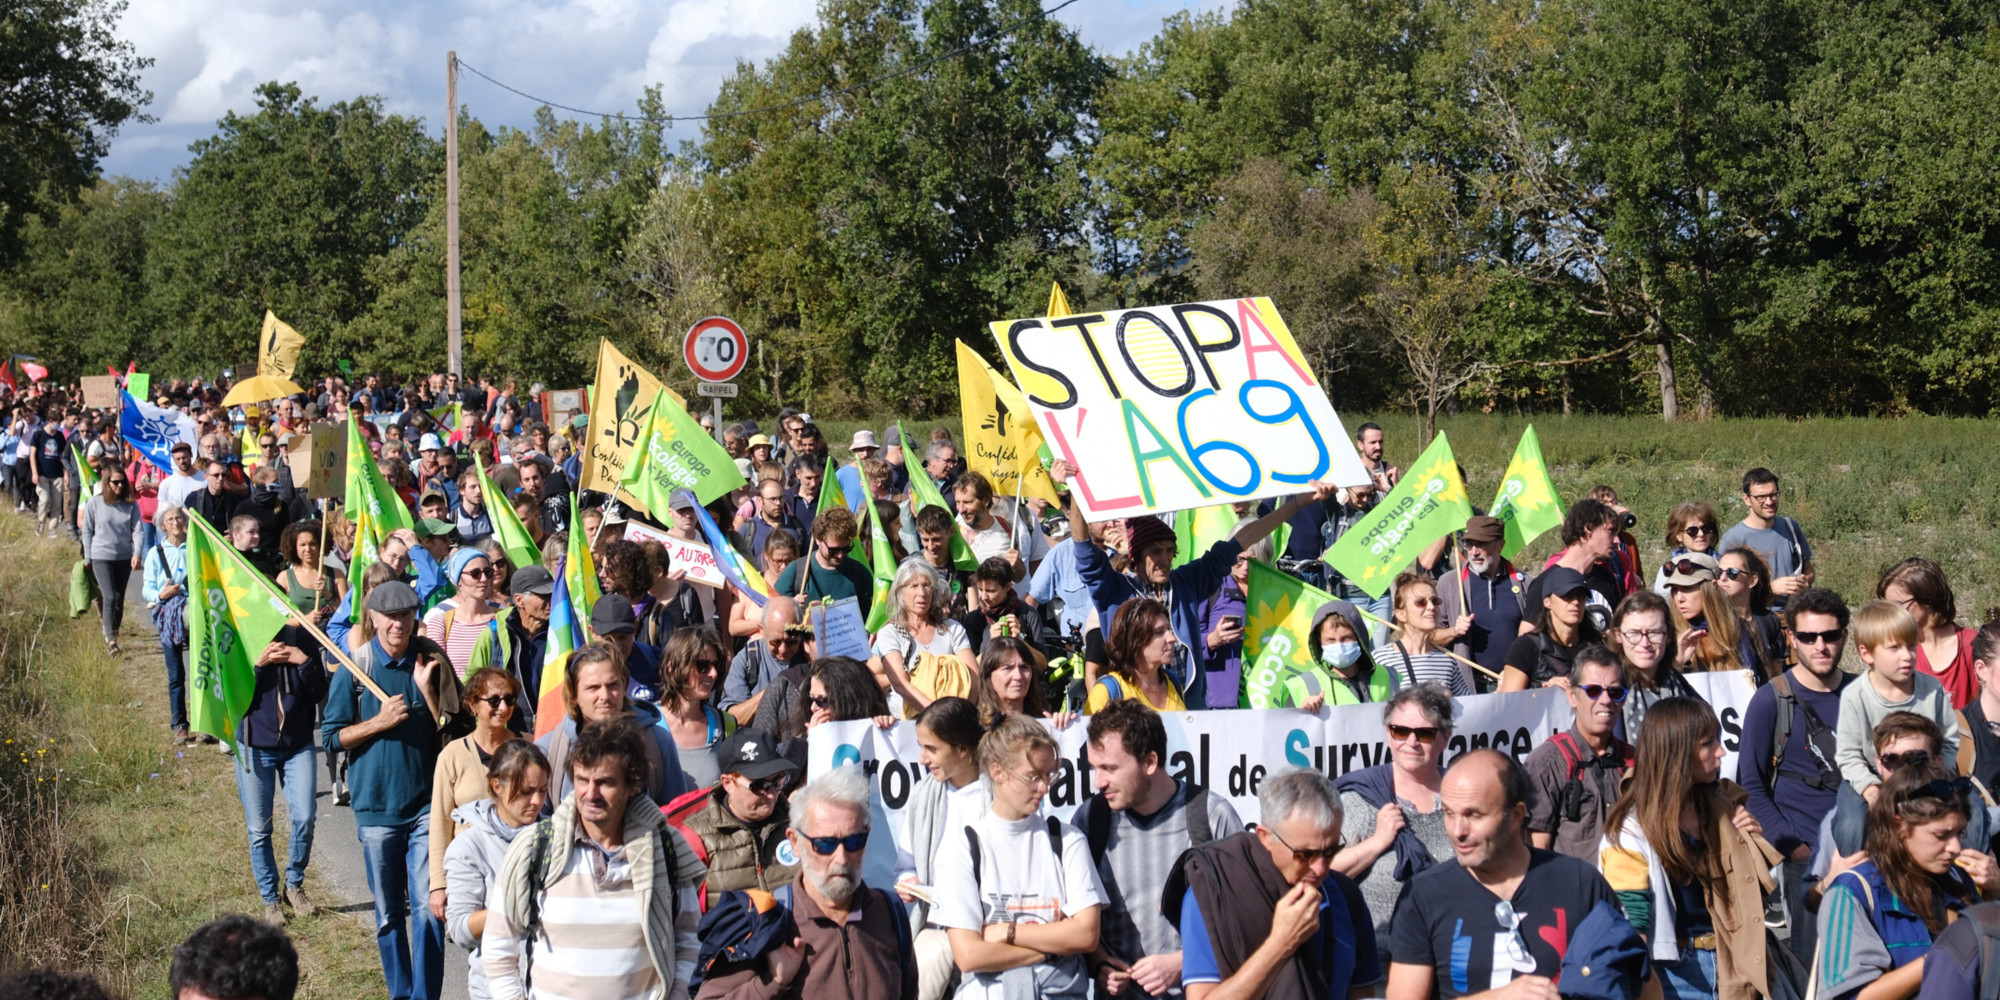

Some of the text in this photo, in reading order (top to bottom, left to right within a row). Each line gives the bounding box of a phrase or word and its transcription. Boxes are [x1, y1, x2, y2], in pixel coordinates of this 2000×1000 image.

[700, 336, 734, 362] 70
[1008, 303, 1241, 410] STOP
[703, 386, 733, 394] RAPPEL
[671, 439, 712, 478] europe
[1229, 753, 1267, 798] de
